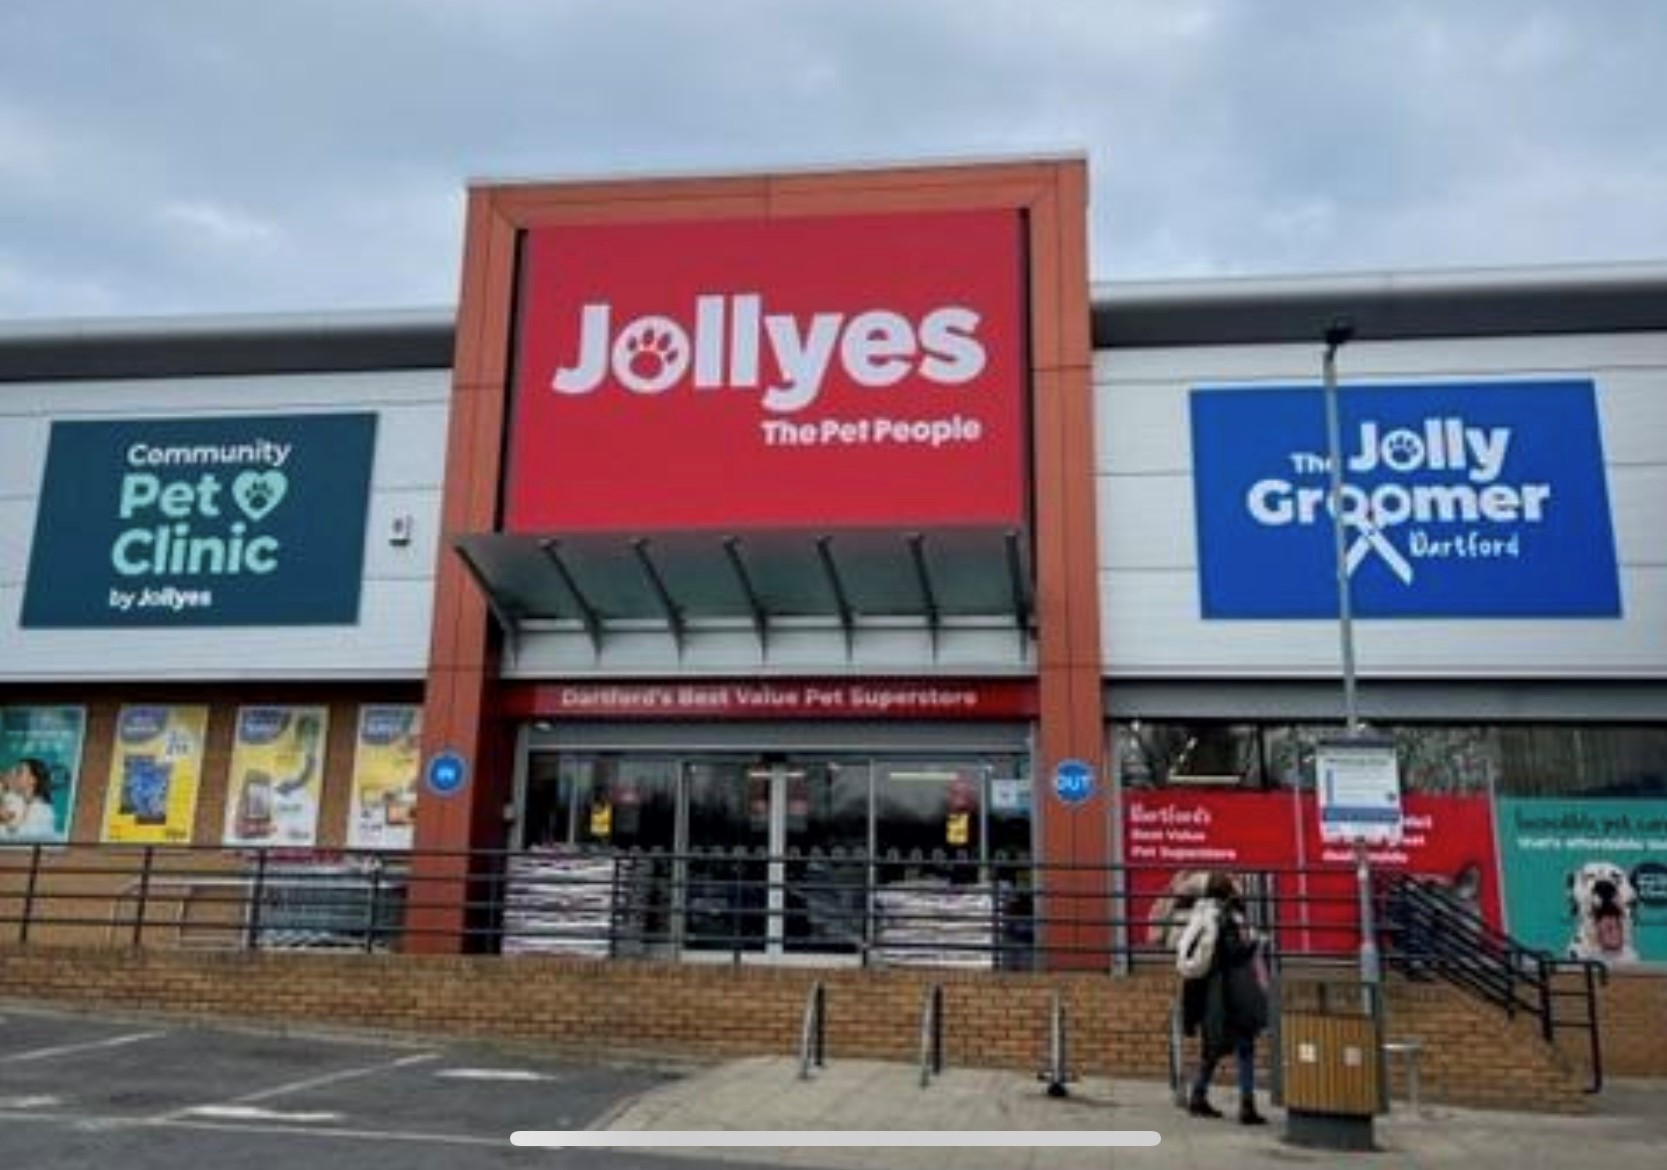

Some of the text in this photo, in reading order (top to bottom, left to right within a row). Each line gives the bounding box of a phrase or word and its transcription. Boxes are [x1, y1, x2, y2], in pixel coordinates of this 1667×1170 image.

[551, 293, 987, 411] Jollyes
[761, 416, 983, 447] The Pet People
[127, 438, 291, 468] Community
[1348, 417, 1511, 482] Jolly
[119, 472, 222, 519] Pet
[1246, 479, 1551, 528] Groomer
[111, 522, 280, 576] Clinic
[1409, 529, 1520, 558] Dartford
[109, 587, 212, 612] by Jollyes
[561, 686, 978, 709] Dartford's Best Value Pet Superstore
[1056, 774, 1091, 791] OUT
